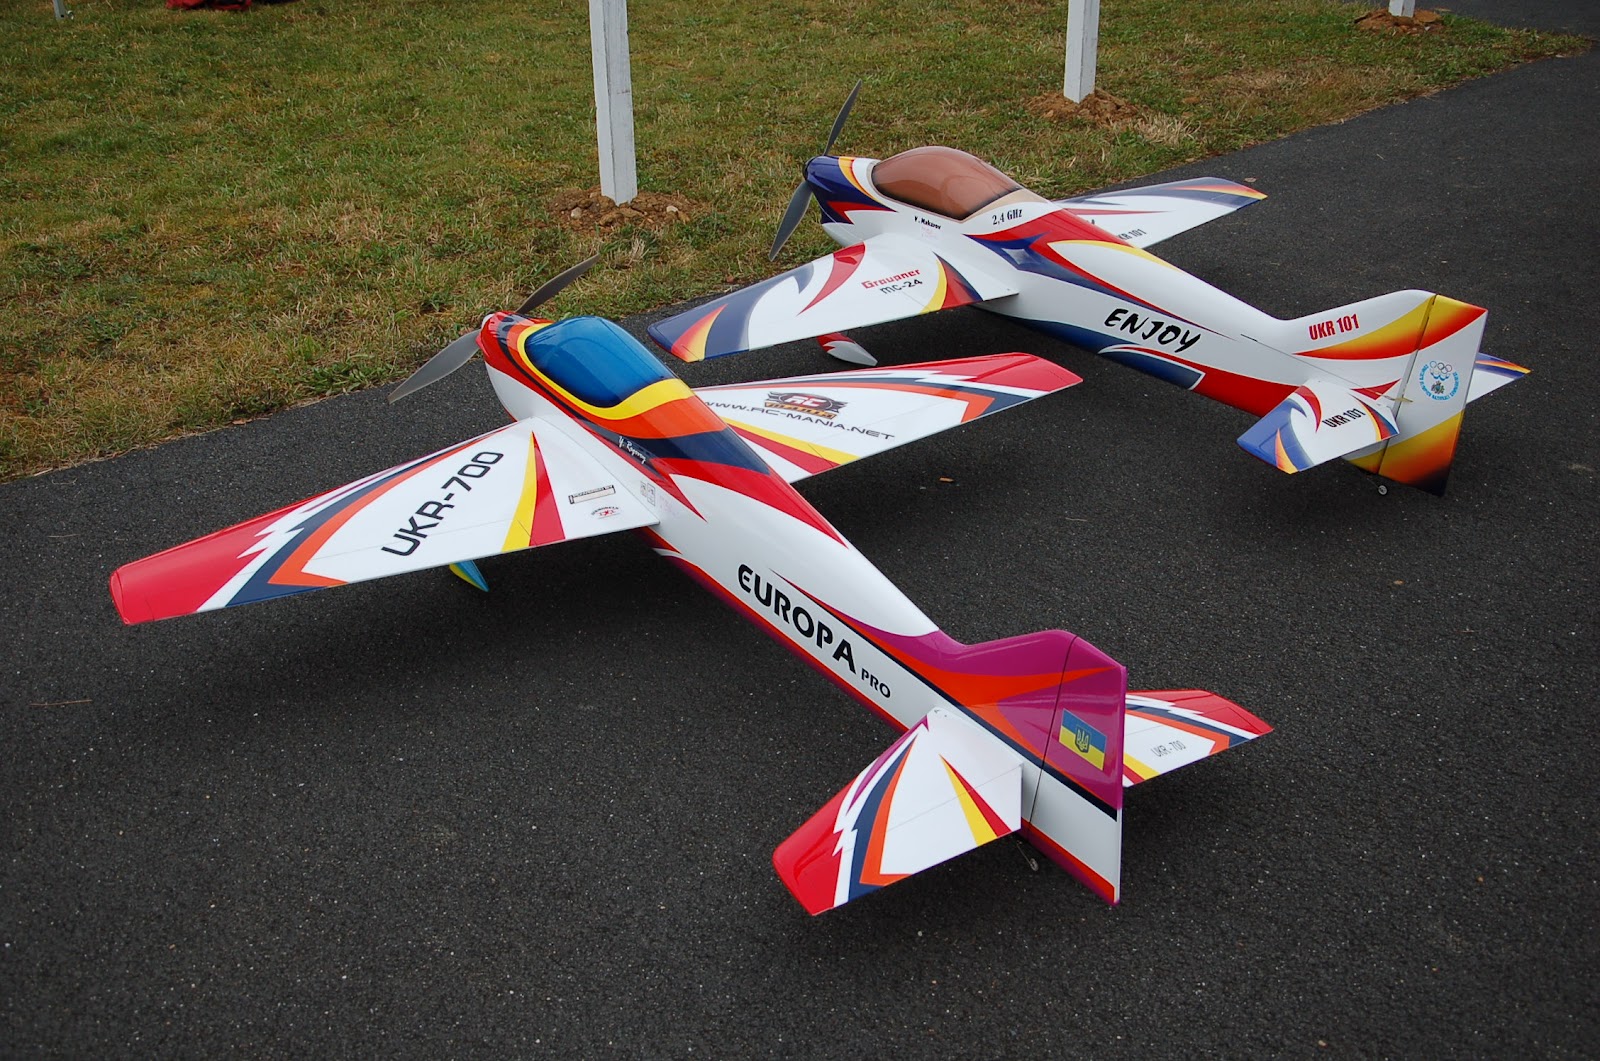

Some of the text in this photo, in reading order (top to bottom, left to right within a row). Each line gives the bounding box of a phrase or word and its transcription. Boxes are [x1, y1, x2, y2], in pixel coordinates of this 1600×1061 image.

[861, 269, 920, 289] Graupner
[1104, 308, 1201, 353] ENJOY
[1309, 313, 1360, 340] UKR 101
[1322, 408, 1367, 428] UKR 101
[381, 451, 504, 556] UKR-700
[738, 563, 891, 699] EUROPA PRO
